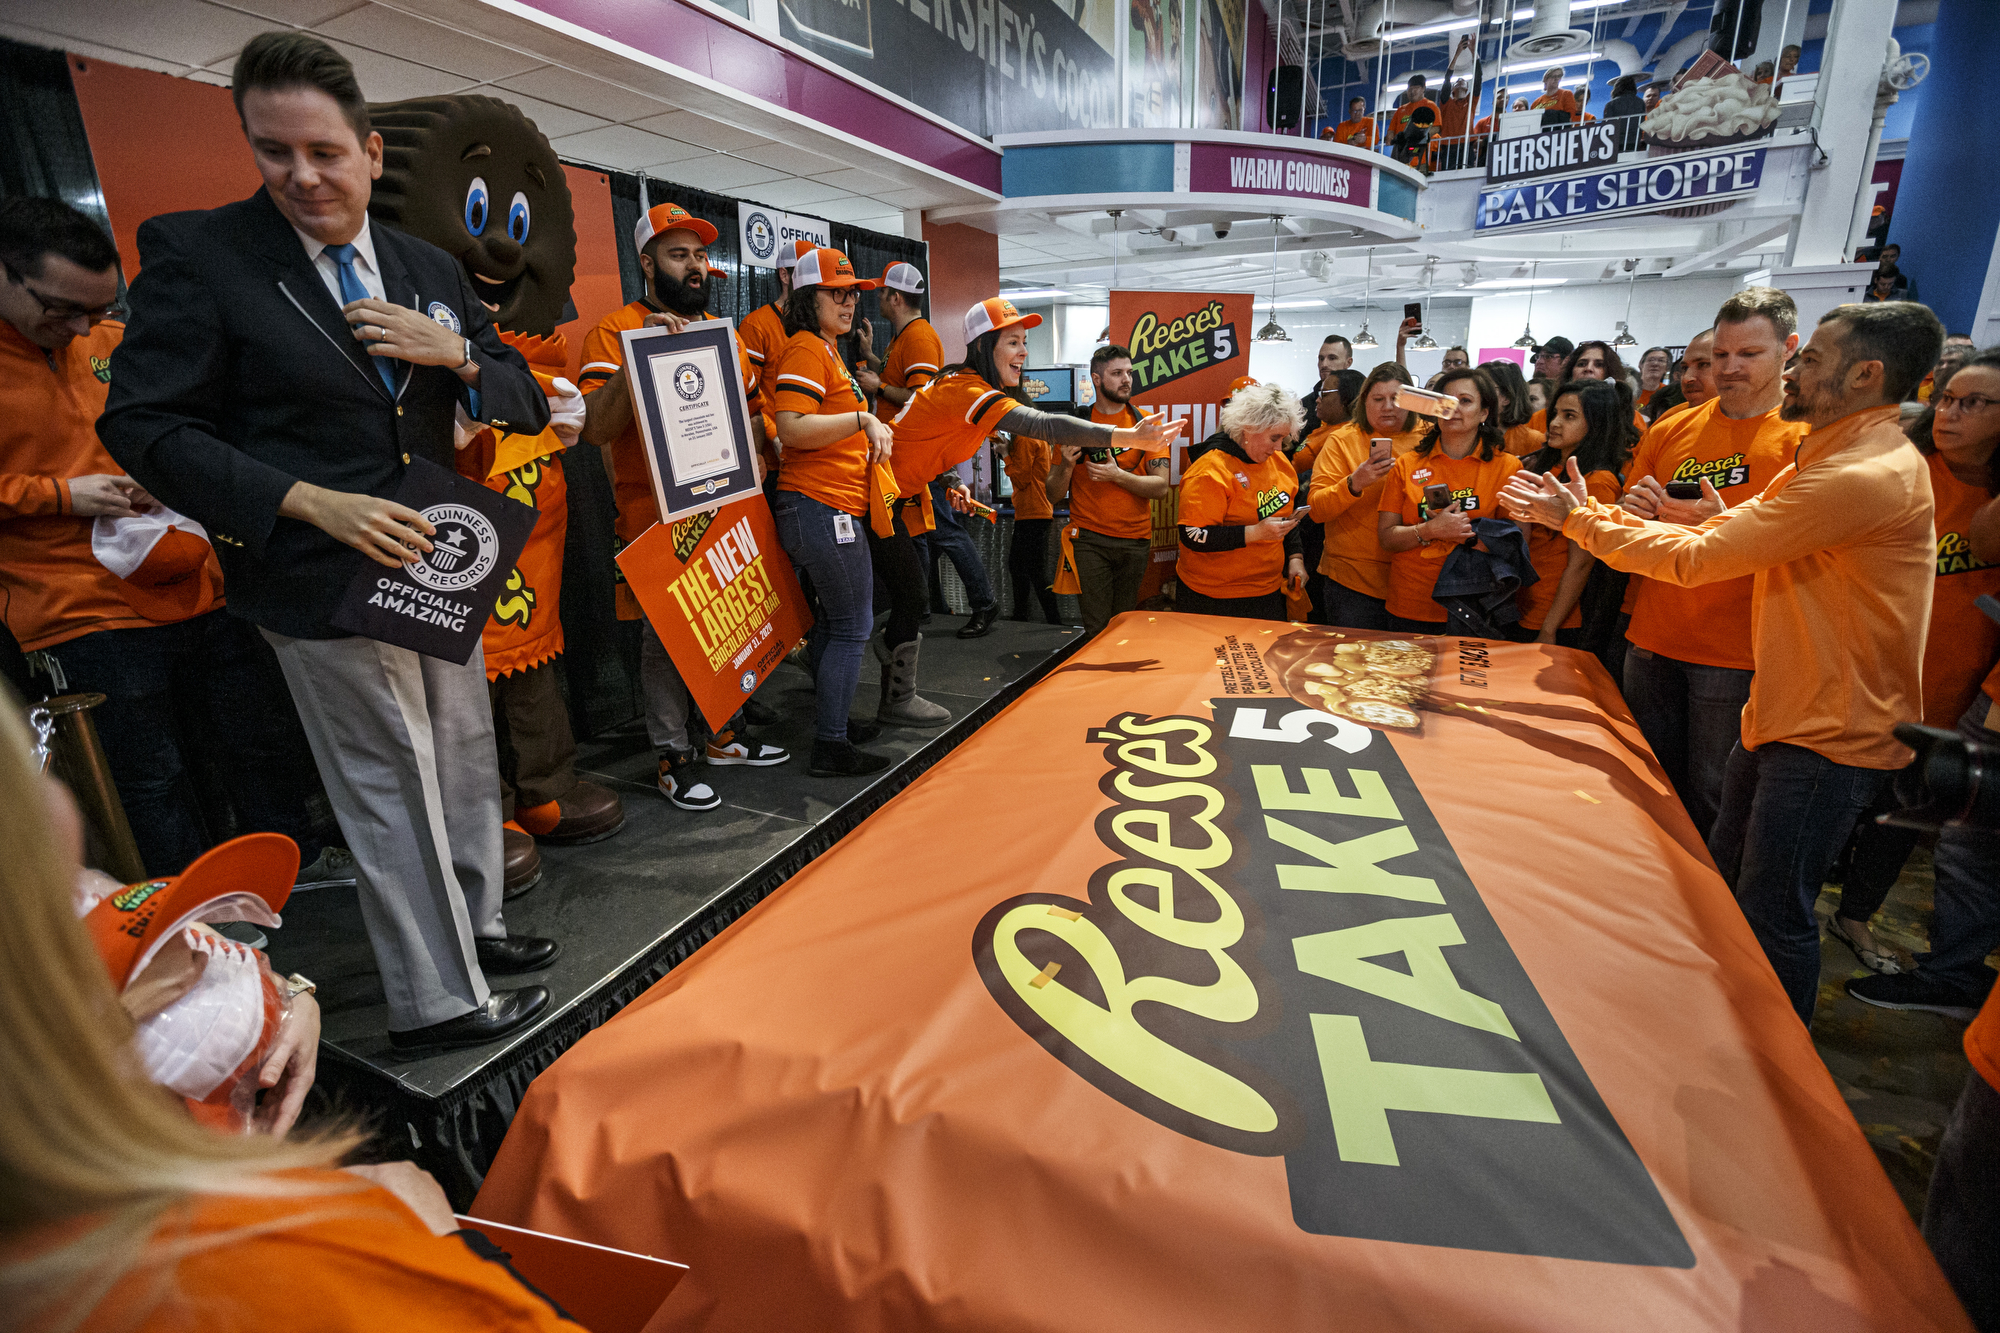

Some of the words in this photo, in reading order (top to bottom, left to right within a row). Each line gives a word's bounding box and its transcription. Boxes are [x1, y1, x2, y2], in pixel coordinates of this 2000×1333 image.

[900, 0, 1047, 99] RSHEY'S
[1052, 48, 1114, 130] COCOA
[1492, 123, 1615, 177] HERSHEY'S
[1230, 156, 1283, 190] WARM
[1286, 160, 1350, 199] GOODNESS
[1484, 179, 1587, 227] BAKE
[1597, 151, 1757, 209] SHOPPE
[781, 226, 827, 247] OFFICIAL
[1131, 302, 1222, 359] Reese's
[676, 365, 698, 378] GUINNESS
[1132, 338, 1208, 387] TAKE
[1213, 329, 1232, 360] 5
[679, 401, 710, 412] CERTIFICATE
[1673, 453, 1744, 481] Reese's
[1728, 467, 1745, 485] 5
[1257, 485, 1279, 508] Reese's
[1259, 498, 1283, 518] TAKE
[1278, 491, 1290, 504] 5
[1464, 497, 1476, 510] 5
[427, 509, 492, 544] GUINNESS
[672, 512, 699, 550] Rees
[677, 514, 710, 558] TAKE
[428, 555, 490, 586] RECORDS
[666, 557, 718, 622] THE
[705, 515, 759, 589] NEW
[1937, 553, 1987, 574] TAK
[368, 591, 467, 633] AMAZING
[377, 577, 473, 618] OFFICIALLY
[690, 554, 773, 658] LARGEST
[708, 622, 752, 672] CHOCOLATE
[748, 605, 766, 634] NUT
[763, 591, 781, 616] BAR
[732, 641, 754, 669] JANUARY
[751, 634, 763, 649] 31,
[759, 622, 774, 640] 2020
[1225, 635, 1241, 651] PEANUTS
[1242, 643, 1257, 651] BAR
[757, 639, 783, 668] OFFICIAL
[760, 645, 786, 674] ATTEMPT
[1231, 651, 1249, 671] BUTTER,
[1246, 651, 1268, 680] CHOCOLATE
[1220, 665, 1239, 694] PRETZELS,
[1237, 671, 1257, 694] PEANUT
[1229, 707, 1373, 754] 5
[992, 715, 1279, 1133] Reese's
[1251, 764, 1563, 1167] TAKE
